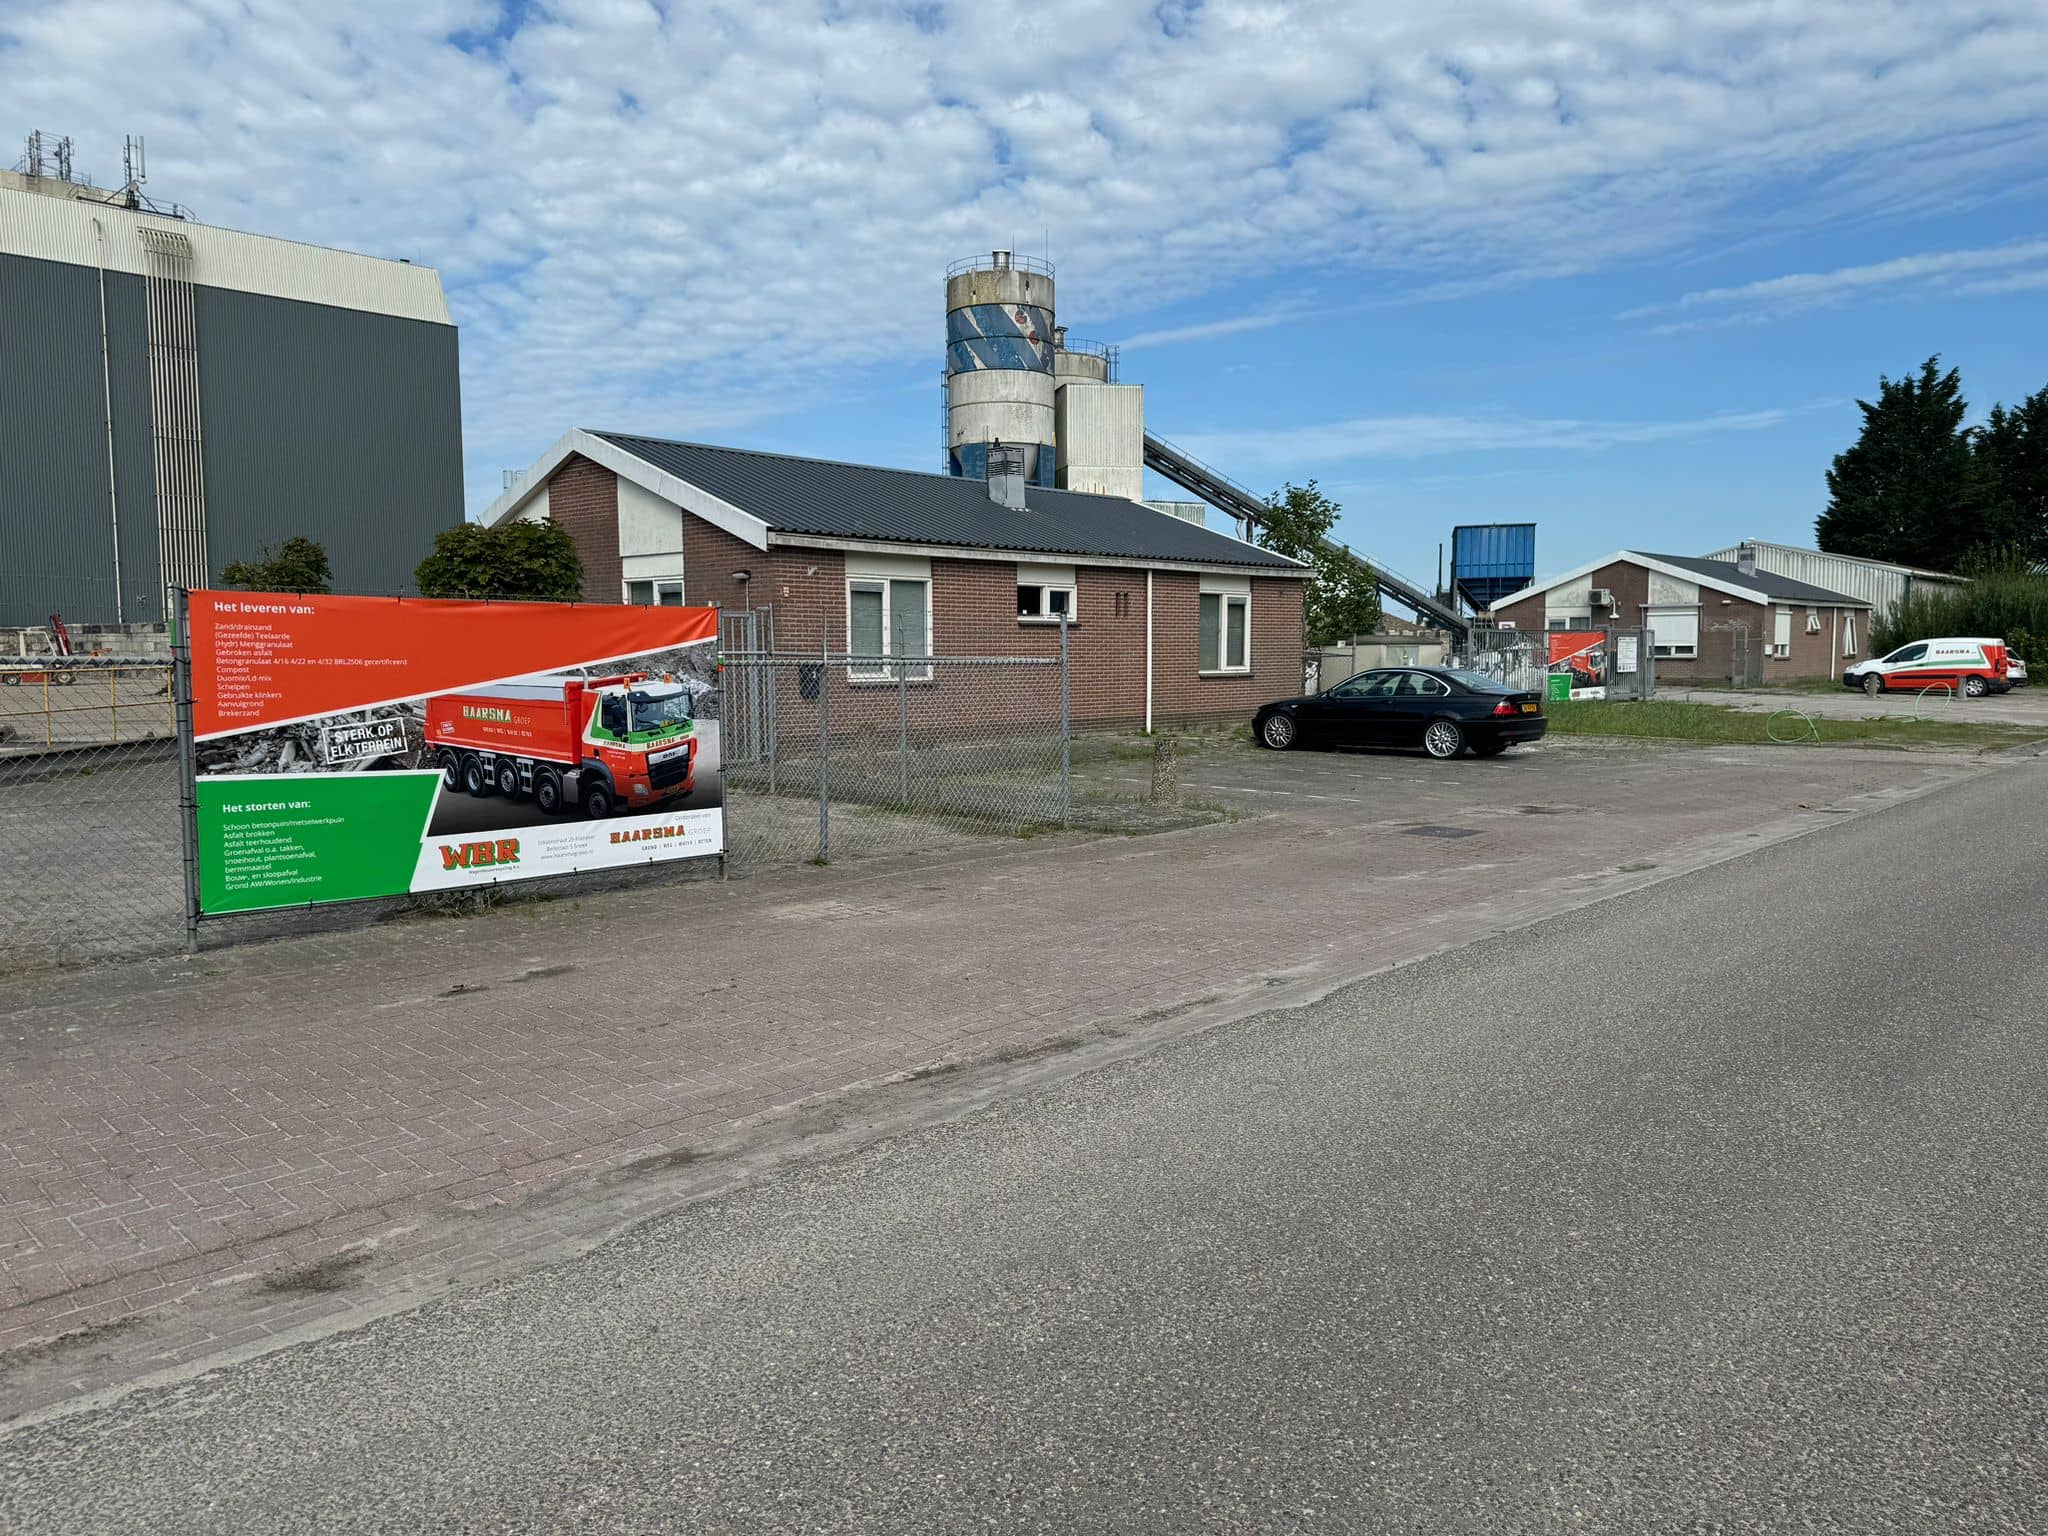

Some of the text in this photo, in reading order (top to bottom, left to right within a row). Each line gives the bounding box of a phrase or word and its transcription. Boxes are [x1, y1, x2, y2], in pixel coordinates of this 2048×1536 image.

[214, 601, 315, 615] Het leveren van:
[215, 623, 272, 632] Zand/drainzand
[215, 631, 290, 640] (Gezeefde) Teelaarde
[215, 640, 293, 650] (Hydr) Menggranulaat
[216, 658, 272, 666] Betongranulaat
[364, 658, 407, 666] gecertificeerd
[216, 666, 249, 674] Compost
[217, 683, 250, 691] Schelpen
[254, 691, 282, 699] klinkers
[218, 700, 264, 709] Aanvulgrond
[218, 709, 260, 717] Brekerzand
[463, 705, 512, 723] HAARSMA
[334, 724, 394, 744] STERK OP
[330, 736, 402, 758] ELK TERREIN
[223, 800, 312, 813] Het storten van:
[223, 823, 250, 832] Schoon
[223, 830, 275, 840] Asfalt brokken
[609, 825, 685, 844] HAARSMA
[223, 837, 293, 848] Asfalt teerhoudend
[224, 847, 264, 857] Groenafval
[438, 838, 520, 871] WBR
[263, 869, 298, 879] sloopafval
[225, 882, 249, 891] Grond
